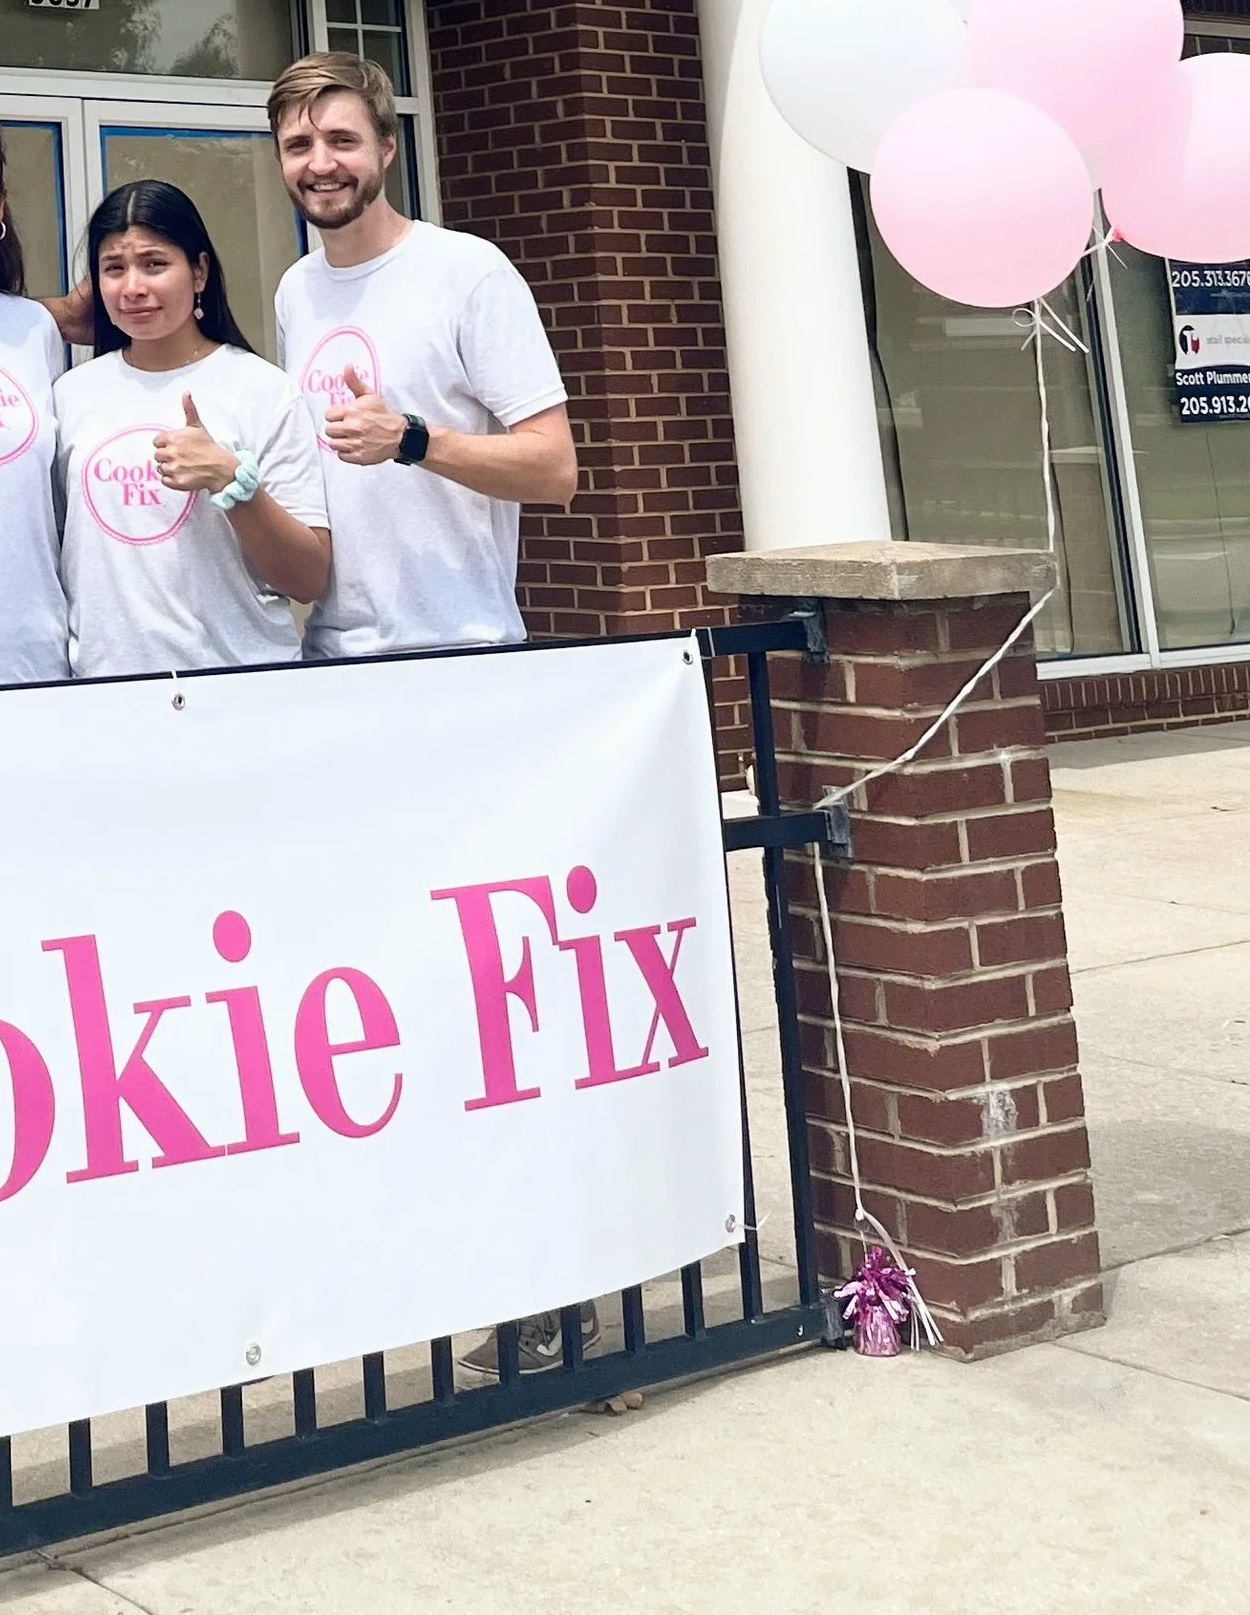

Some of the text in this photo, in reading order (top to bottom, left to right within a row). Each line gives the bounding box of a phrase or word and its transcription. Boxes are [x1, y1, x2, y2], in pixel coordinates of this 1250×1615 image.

[1175, 372, 1205, 386] Scott
[94, 458, 159, 483] Cook
[122, 483, 162, 506] Fix
[430, 864, 710, 1112] Fix
